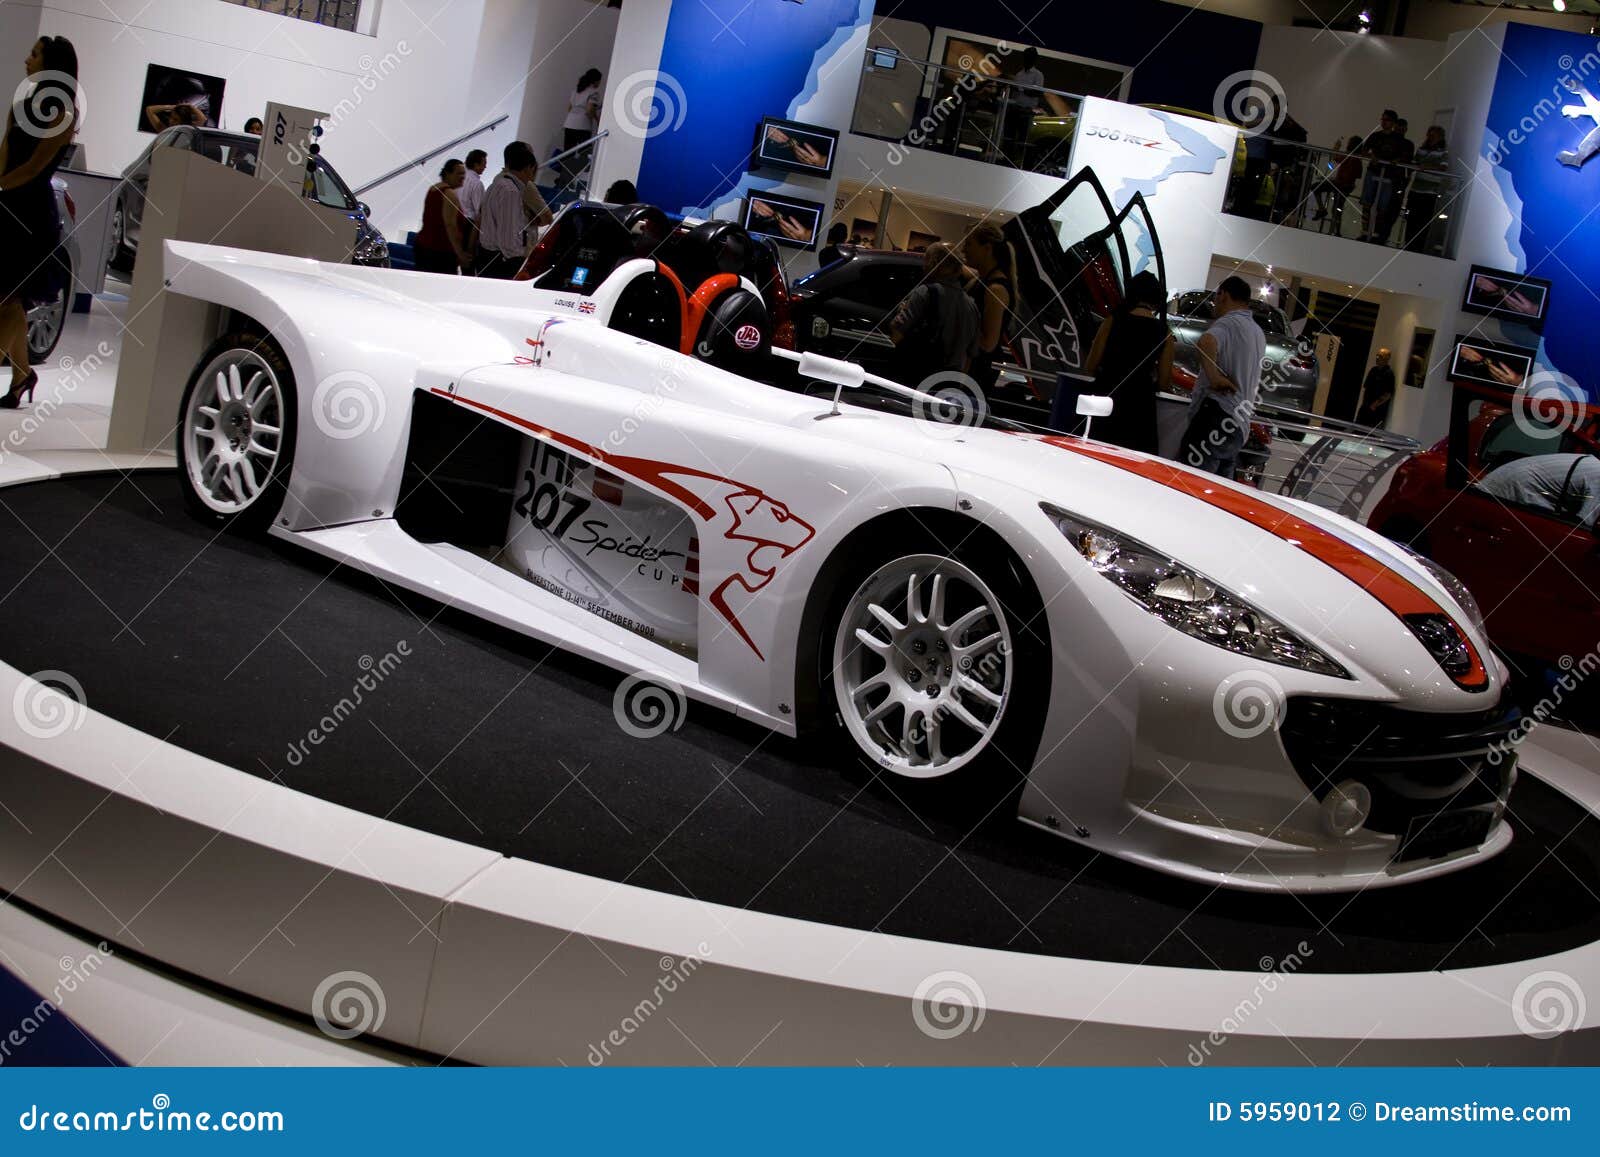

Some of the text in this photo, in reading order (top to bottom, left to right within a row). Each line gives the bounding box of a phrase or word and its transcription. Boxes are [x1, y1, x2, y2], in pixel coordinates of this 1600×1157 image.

[273, 111, 287, 145] 107
[1086, 125, 1120, 141] 308
[554, 299, 576, 309] LOUISE
[514, 469, 686, 562] 207 Spider
[587, 601, 633, 629] SEPTEMBER
[635, 622, 655, 637] 2008
